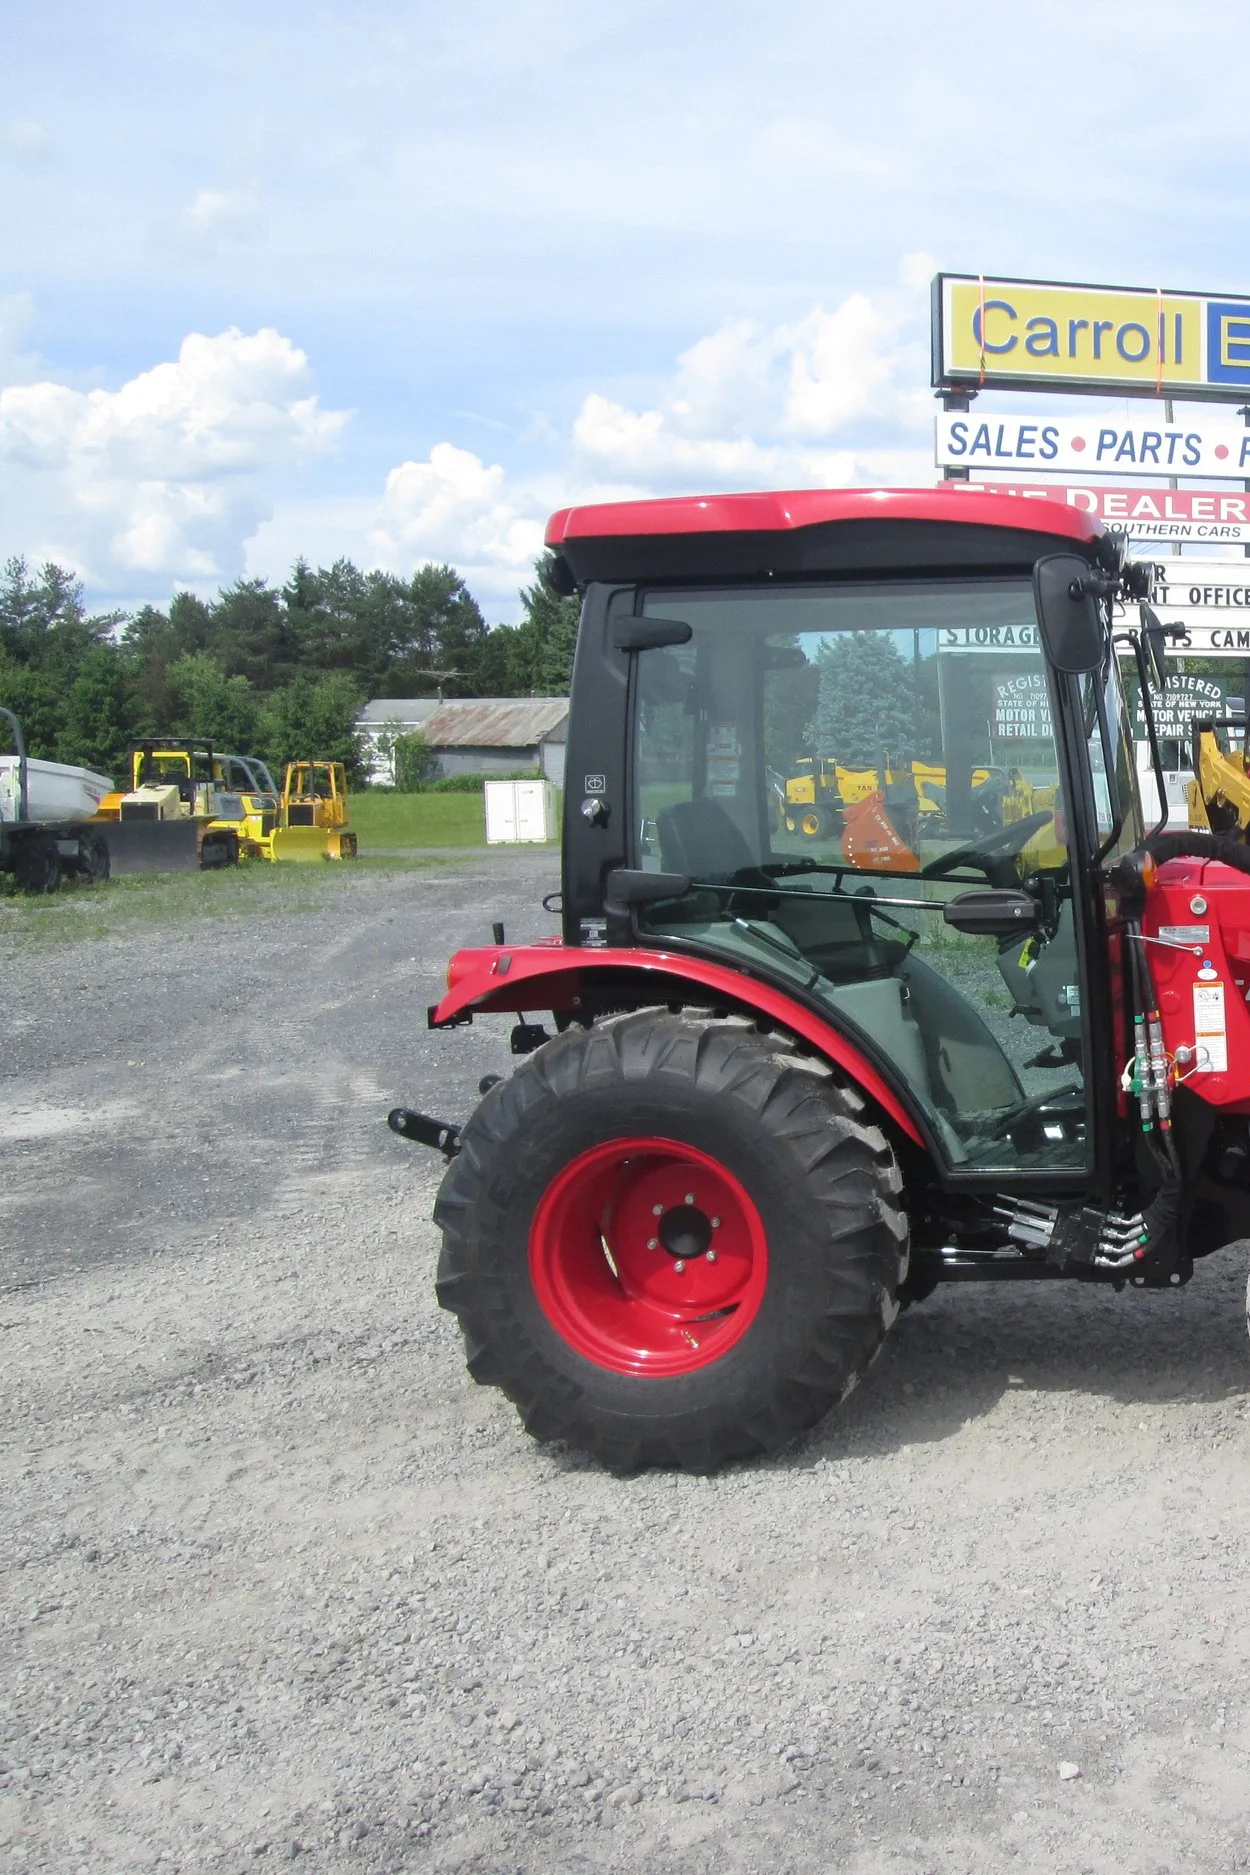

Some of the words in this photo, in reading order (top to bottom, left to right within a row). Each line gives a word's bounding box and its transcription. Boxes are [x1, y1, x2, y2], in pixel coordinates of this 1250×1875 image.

[972, 299, 1182, 365] Carroll
[947, 422, 1059, 459] SALES
[1096, 429, 1201, 465] PARTS
[1066, 488, 1247, 520] DEALER
[1197, 525, 1241, 538] CARS
[1137, 676, 1221, 699] EISTERED
[996, 709, 1036, 721] MOTOR
[1137, 710, 1174, 722] MTOR
[998, 723, 1038, 736] RETAIL
